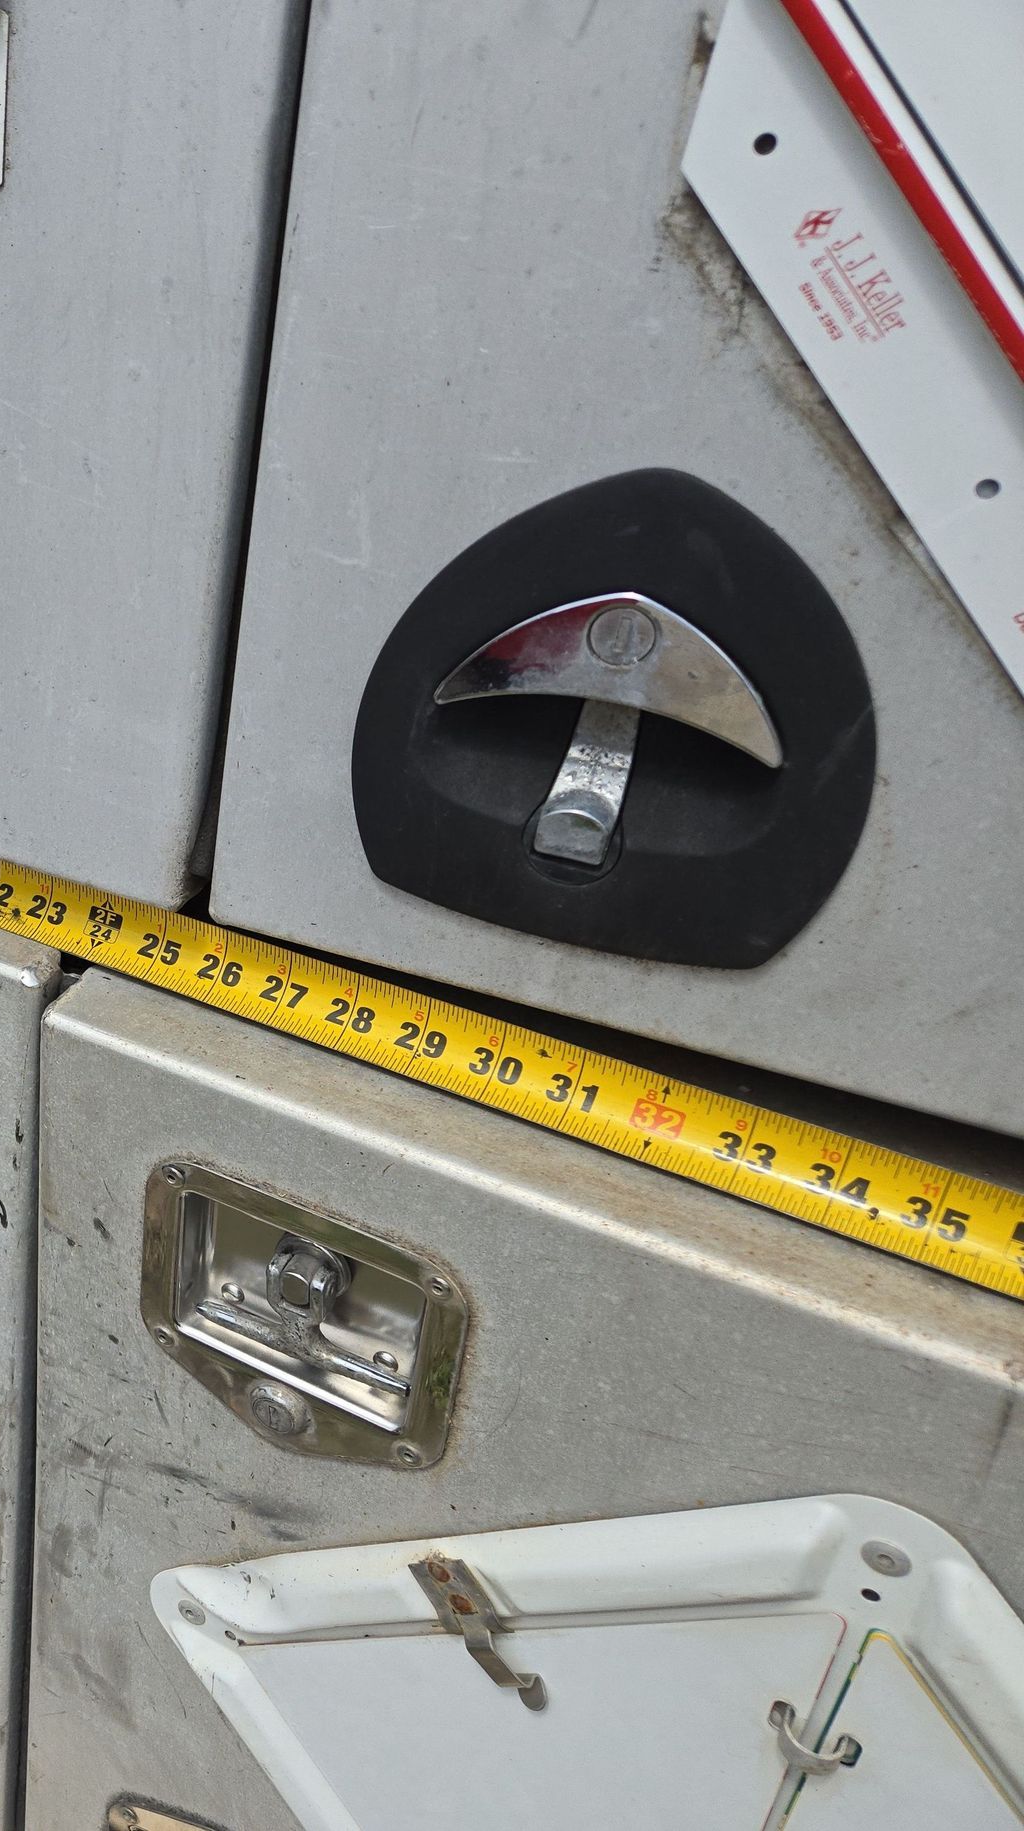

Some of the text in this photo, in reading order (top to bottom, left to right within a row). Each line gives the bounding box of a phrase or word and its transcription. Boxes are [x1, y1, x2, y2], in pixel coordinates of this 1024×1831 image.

[799, 282, 844, 341] Since 1953
[857, 269, 906, 332] Keller
[95, 909, 116, 925] 2F
[26, 895, 68, 925] 23
[88, 925, 112, 942] 24
[137, 933, 182, 966] 25
[196, 953, 243, 987] 26
[259, 975, 309, 1009] 27
[324, 998, 376, 1034] 28
[394, 1021, 447, 1058] 29
[468, 1047, 523, 1085] 30
[545, 1073, 600, 1113] 31
[632, 1103, 683, 1136] 32
[712, 1131, 777, 1174] 33
[803, 1163, 869, 1206] 34
[900, 1196, 971, 1242] 35
[39, 883, 50, 895] 11
[157, 922, 163, 933] 1
[214, 942, 223, 953] 2
[277, 964, 287, 976] 3
[344, 987, 354, 999] 4
[414, 1010, 425, 1022] 5
[488, 1035, 499, 1048] 6
[567, 1061, 578, 1074] 7
[646, 1089, 658, 1101] 8
[735, 1119, 748, 1132] 9
[820, 1148, 842, 1164] 10
[922, 1182, 940, 1196] 11
